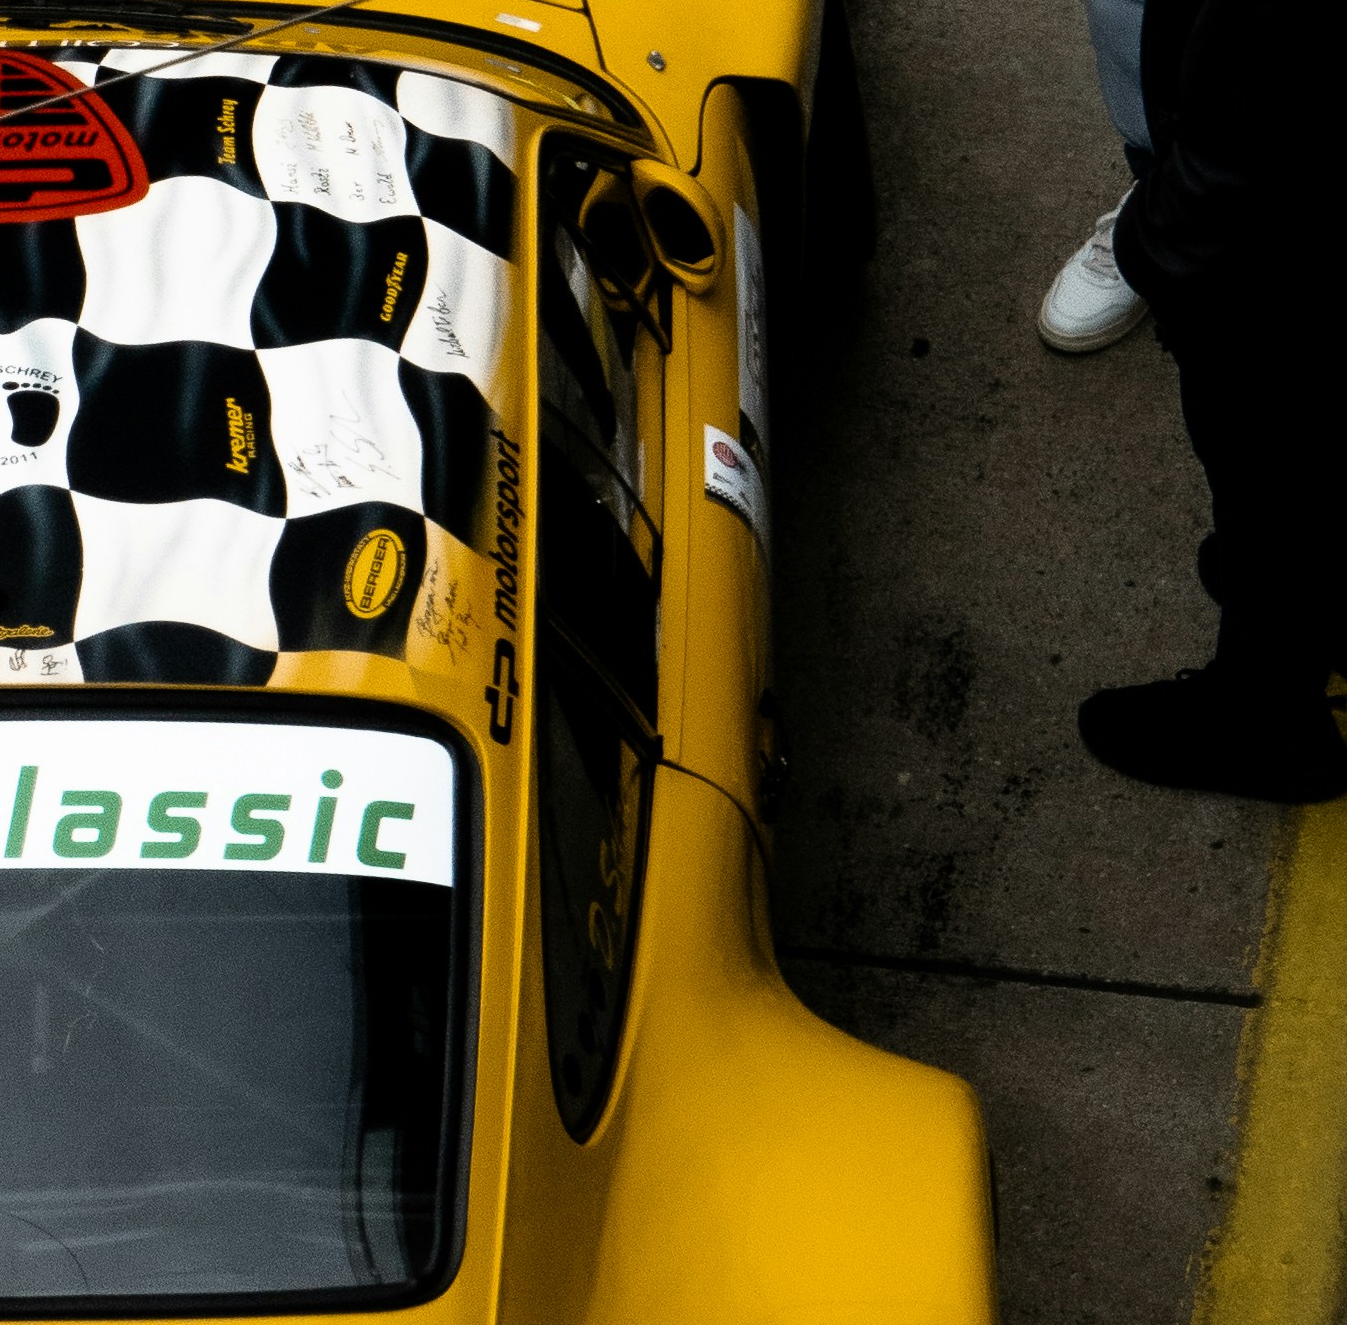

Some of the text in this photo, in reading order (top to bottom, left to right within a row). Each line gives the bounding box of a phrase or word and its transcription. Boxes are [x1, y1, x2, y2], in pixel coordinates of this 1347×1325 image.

[217, 98, 239, 165] Team Schrey
[379, 251, 409, 322] GOODYEAR
[224, 397, 249, 474] kremer
[244, 412, 256, 459] RACING
[494, 429, 524, 632] motorsport
[359, 537, 389, 609] BERGER
